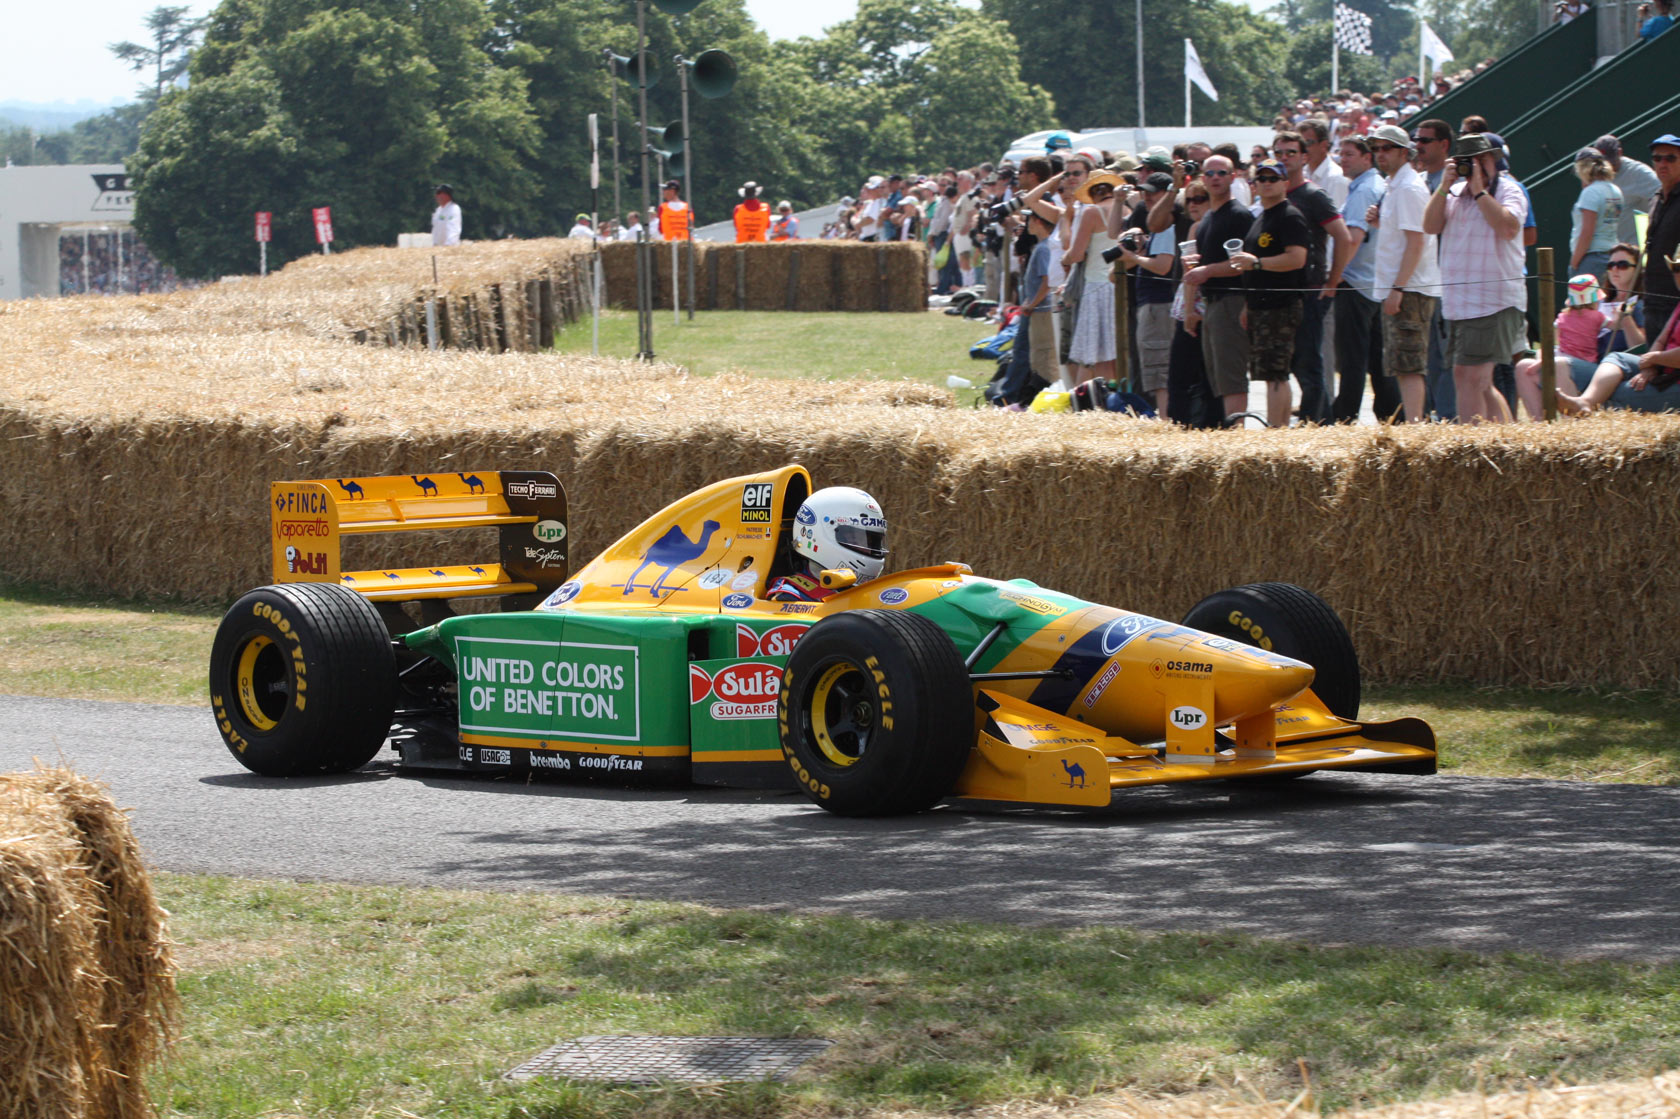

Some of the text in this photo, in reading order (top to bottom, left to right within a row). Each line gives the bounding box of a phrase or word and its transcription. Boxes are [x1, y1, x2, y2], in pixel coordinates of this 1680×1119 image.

[288, 492, 327, 514] FINCA
[744, 485, 771, 506] elf
[742, 511, 770, 521] MINOL
[276, 518, 329, 541] Vaporetto
[537, 524, 562, 540] Lpr
[726, 594, 748, 607] Ford
[463, 656, 624, 690] UNITED COLORS
[1166, 660, 1213, 673] osama
[865, 655, 894, 731] EAGLE
[470, 686, 618, 720] OF BENETTON.
[718, 704, 778, 716] SUGARFR
[213, 695, 248, 753] EAGLE
[1173, 709, 1202, 725] Lpr
[529, 751, 571, 770] brembo
[579, 754, 643, 771] GOODYEAR
